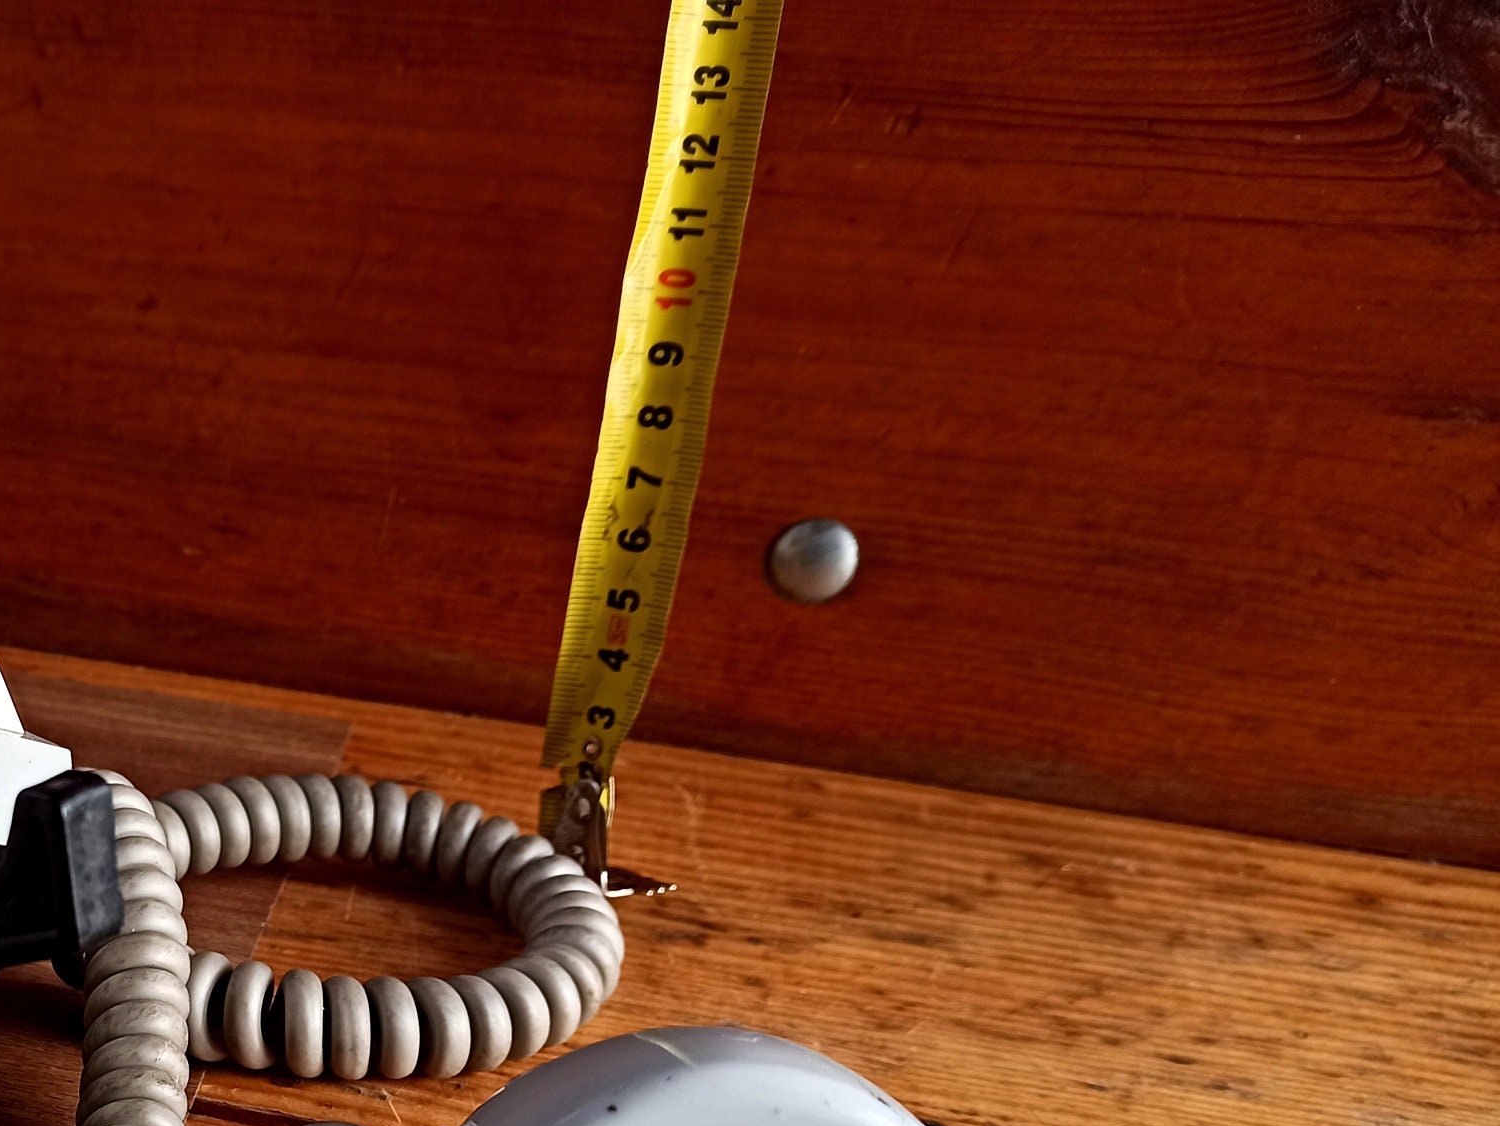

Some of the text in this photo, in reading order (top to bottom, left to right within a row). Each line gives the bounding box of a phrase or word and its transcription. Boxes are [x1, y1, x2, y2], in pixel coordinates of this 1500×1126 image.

[691, 66, 731, 104] 13
[679, 134, 720, 173] 12
[668, 207, 708, 241] 11
[655, 268, 696, 310] 10
[648, 341, 684, 367] 9
[638, 405, 673, 430] 8
[626, 466, 663, 490] 7
[618, 526, 652, 553] 6
[606, 589, 640, 613] 5
[598, 648, 629, 672] 4
[587, 706, 615, 729] 3
